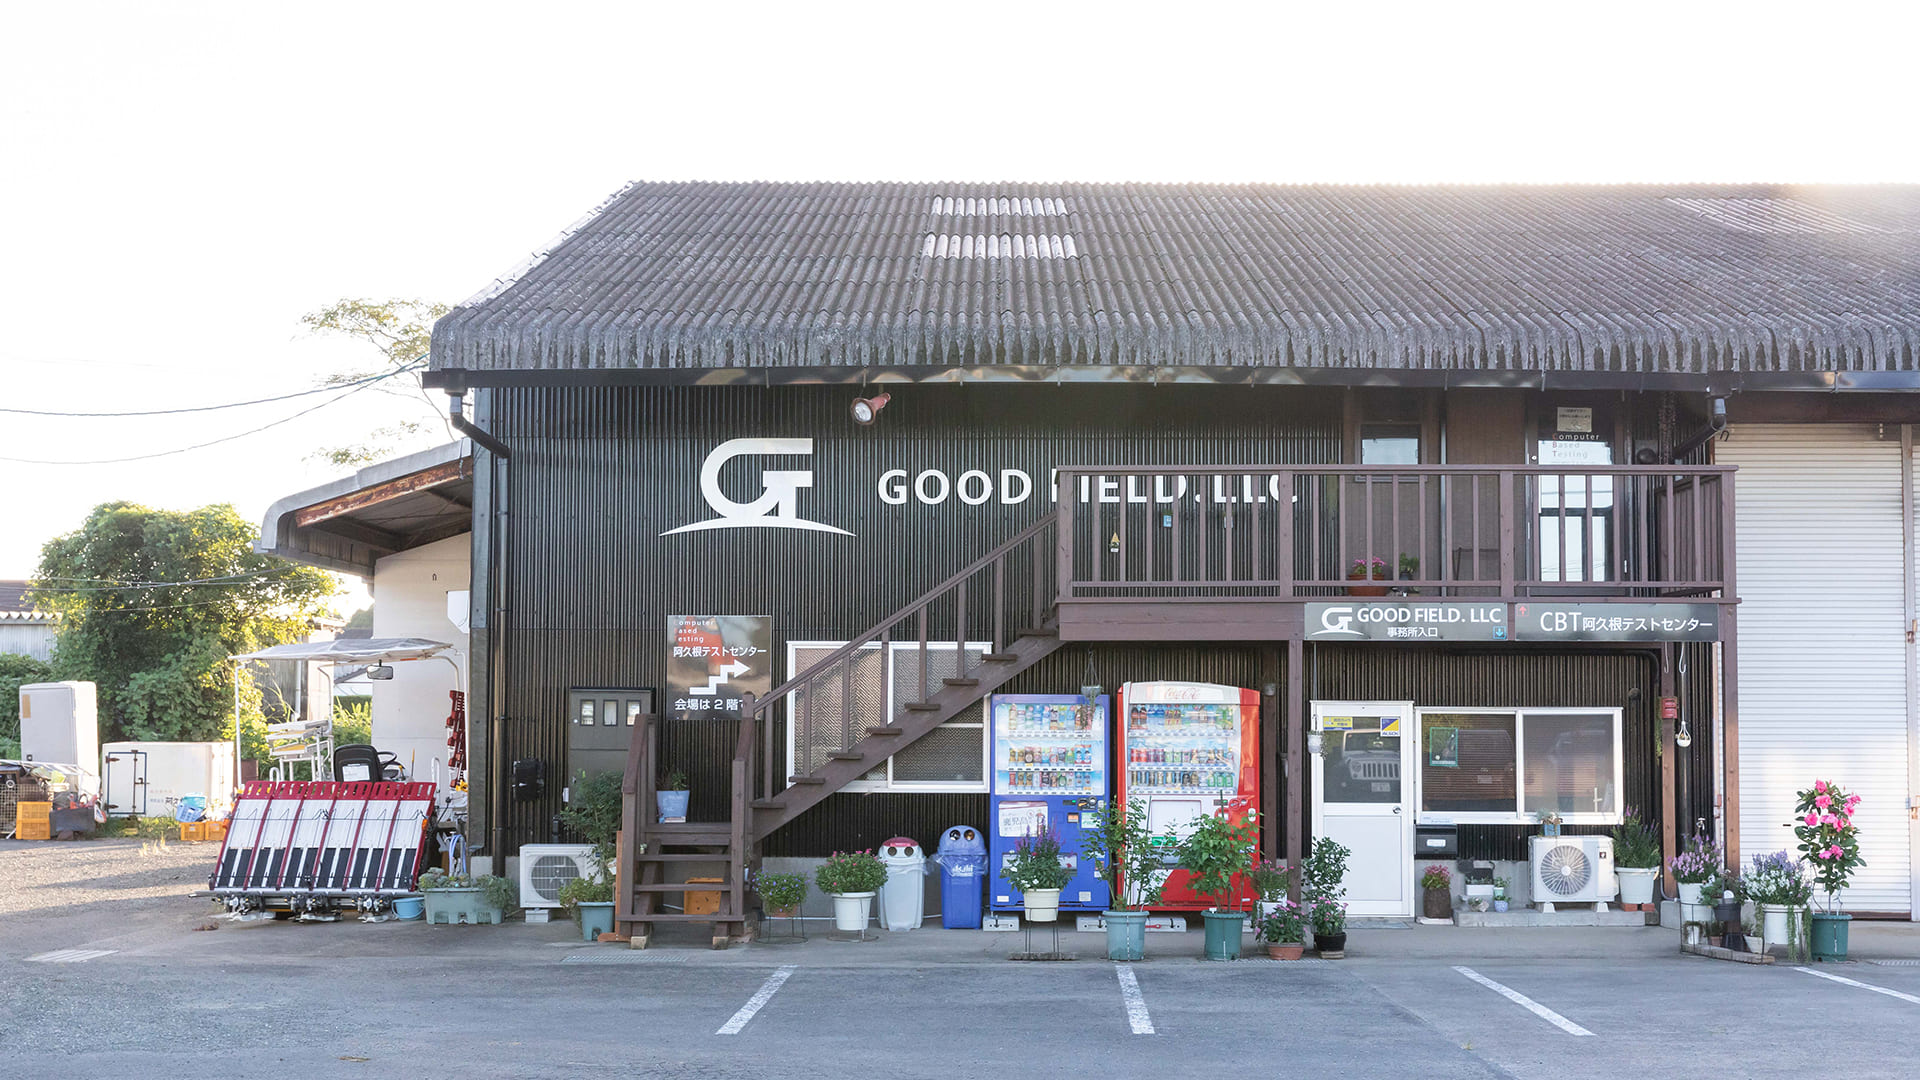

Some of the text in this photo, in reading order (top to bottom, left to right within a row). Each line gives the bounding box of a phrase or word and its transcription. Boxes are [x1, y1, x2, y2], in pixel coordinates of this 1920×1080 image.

[878, 469, 1032, 505] GOOD
[1357, 607, 1502, 623] GOOD FIELD. LLC
[1387, 626, 1438, 638] 事務所入口
[673, 646, 767, 658] 阿久根テストセンター
[674, 698, 760, 711] 会場は2階
